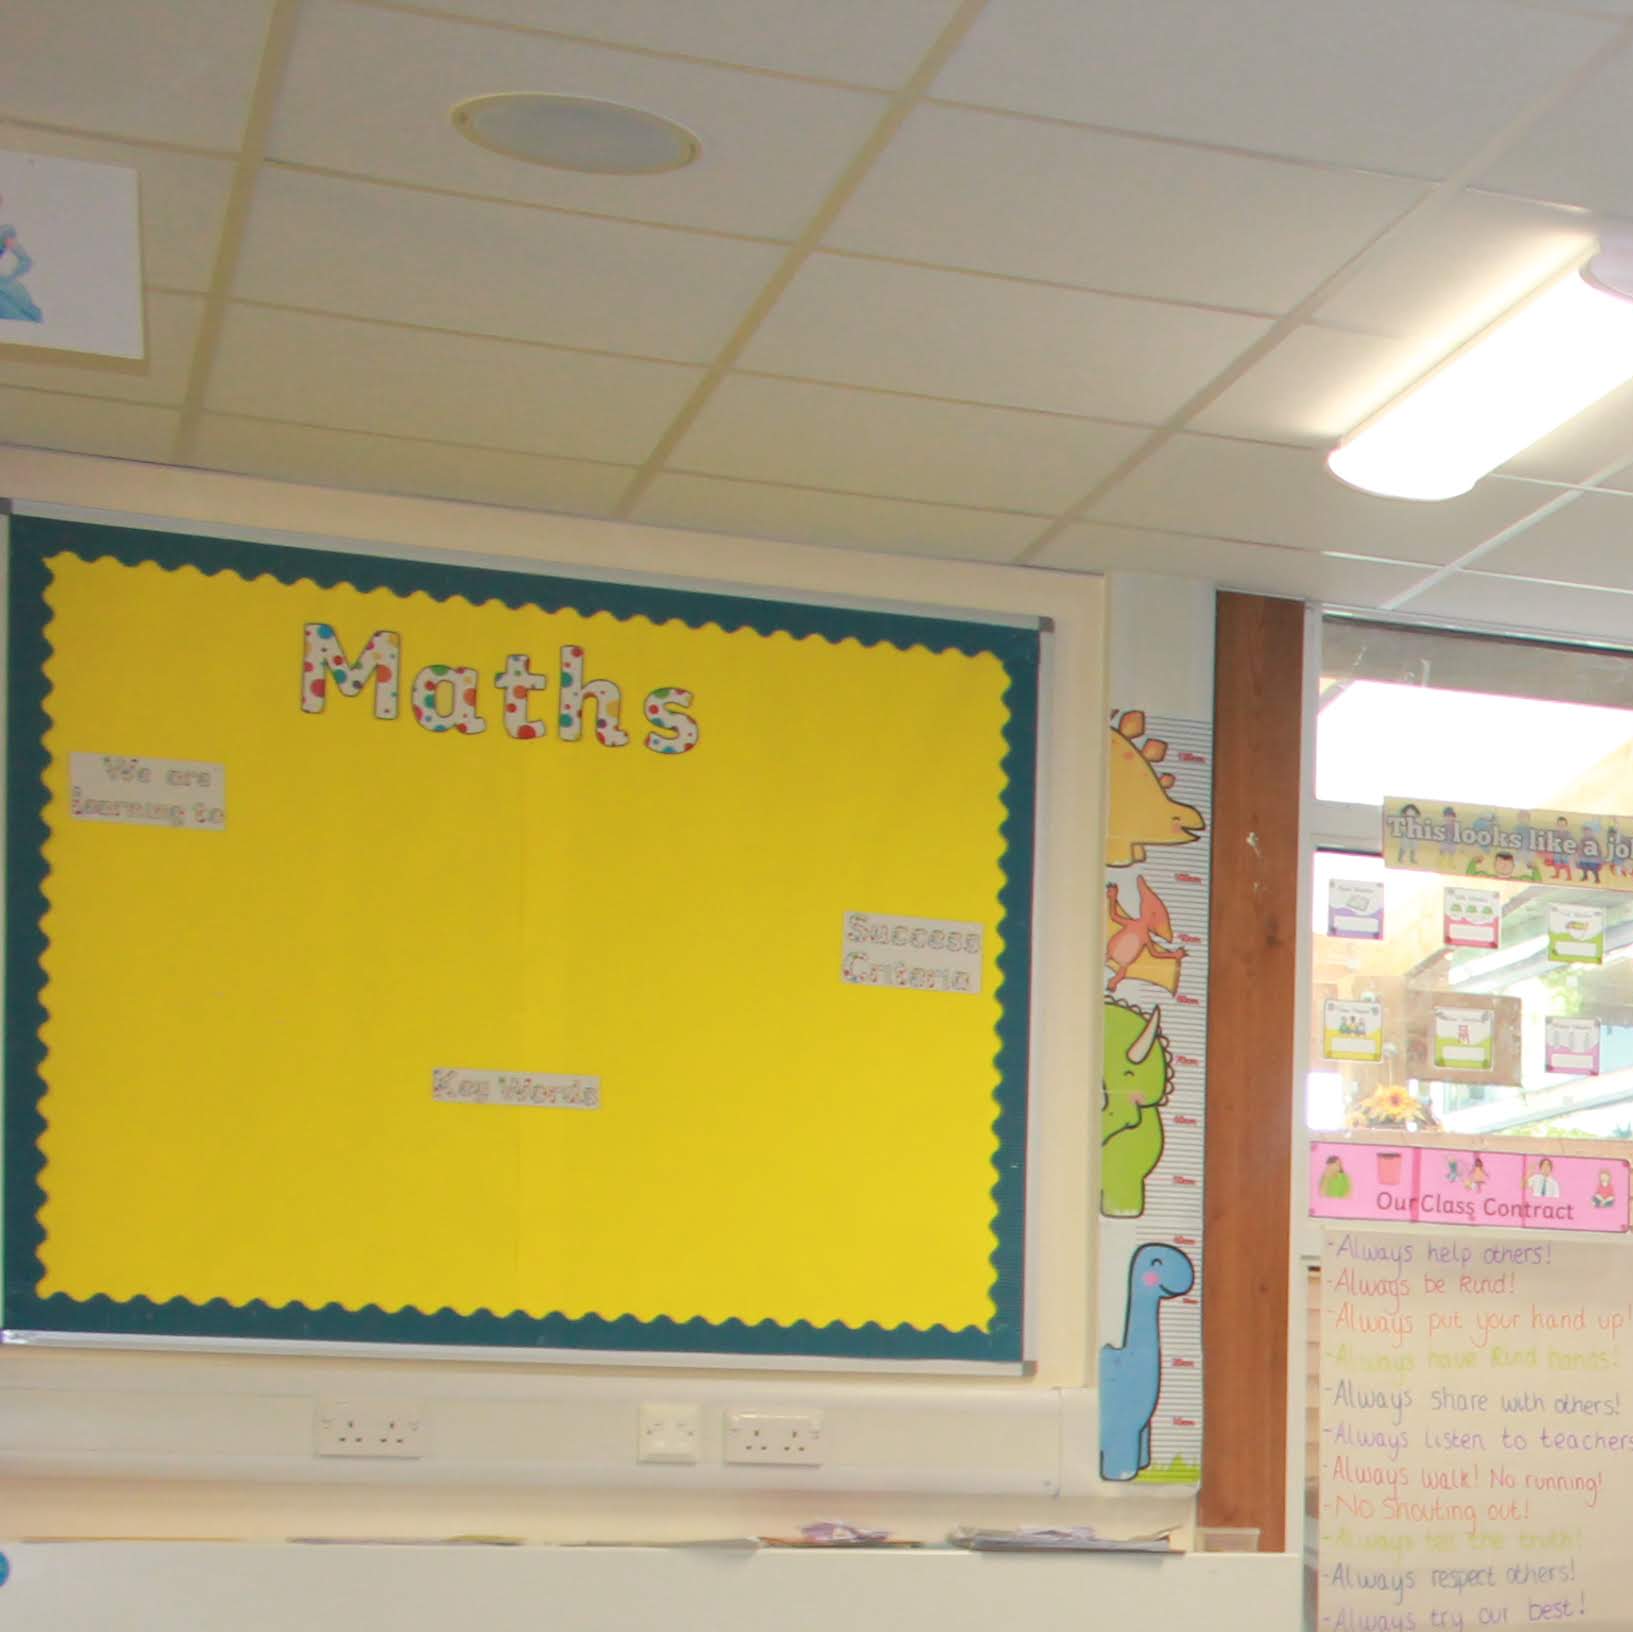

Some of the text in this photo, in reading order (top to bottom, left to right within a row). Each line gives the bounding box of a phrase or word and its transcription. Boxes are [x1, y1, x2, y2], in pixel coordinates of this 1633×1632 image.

[299, 621, 701, 757] Maths
[1386, 815, 1445, 841] This
[1453, 821, 1522, 849] looks
[1530, 829, 1576, 855] like
[1583, 838, 1601, 857] a
[848, 913, 981, 954] Success
[1377, 1192, 1574, 1220] Our Class Contract
[1428, 1241, 1472, 1268] help
[1424, 1273, 1445, 1293] be
[1429, 1310, 1462, 1335] put
[1470, 1311, 1521, 1348] your
[1532, 1303, 1585, 1329] hand
[1431, 1388, 1489, 1412] share
[1501, 1391, 1546, 1413] with
[1502, 1428, 1528, 1449] to
[1490, 1468, 1515, 1489] No
[1431, 1568, 1496, 1594] respect
[1479, 1608, 1509, 1625] our
